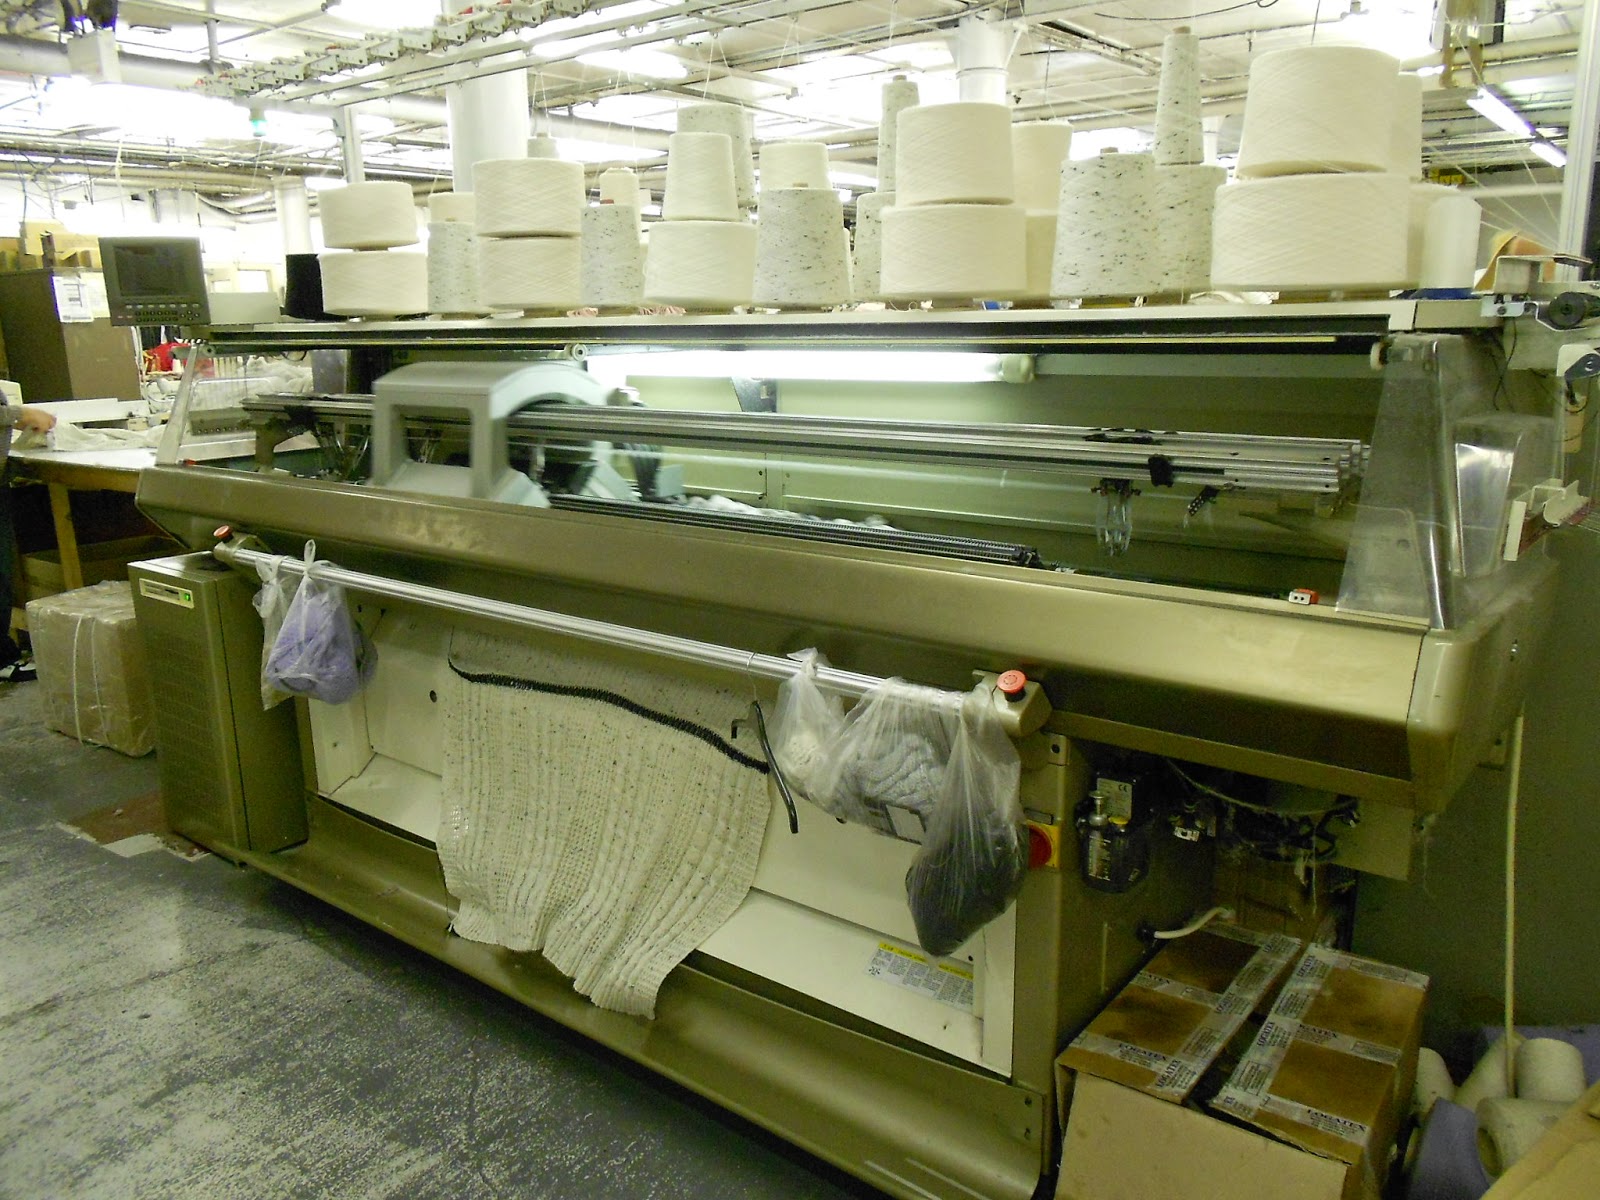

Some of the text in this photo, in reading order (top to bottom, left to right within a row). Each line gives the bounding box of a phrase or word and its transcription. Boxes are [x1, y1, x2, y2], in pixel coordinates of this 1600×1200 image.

[1256, 1021, 1275, 1047] LOGATEX
[1118, 1043, 1168, 1062] LOGATEX
[1156, 1060, 1181, 1087] LOGATEX
[1307, 1108, 1368, 1132] LOGATEX
